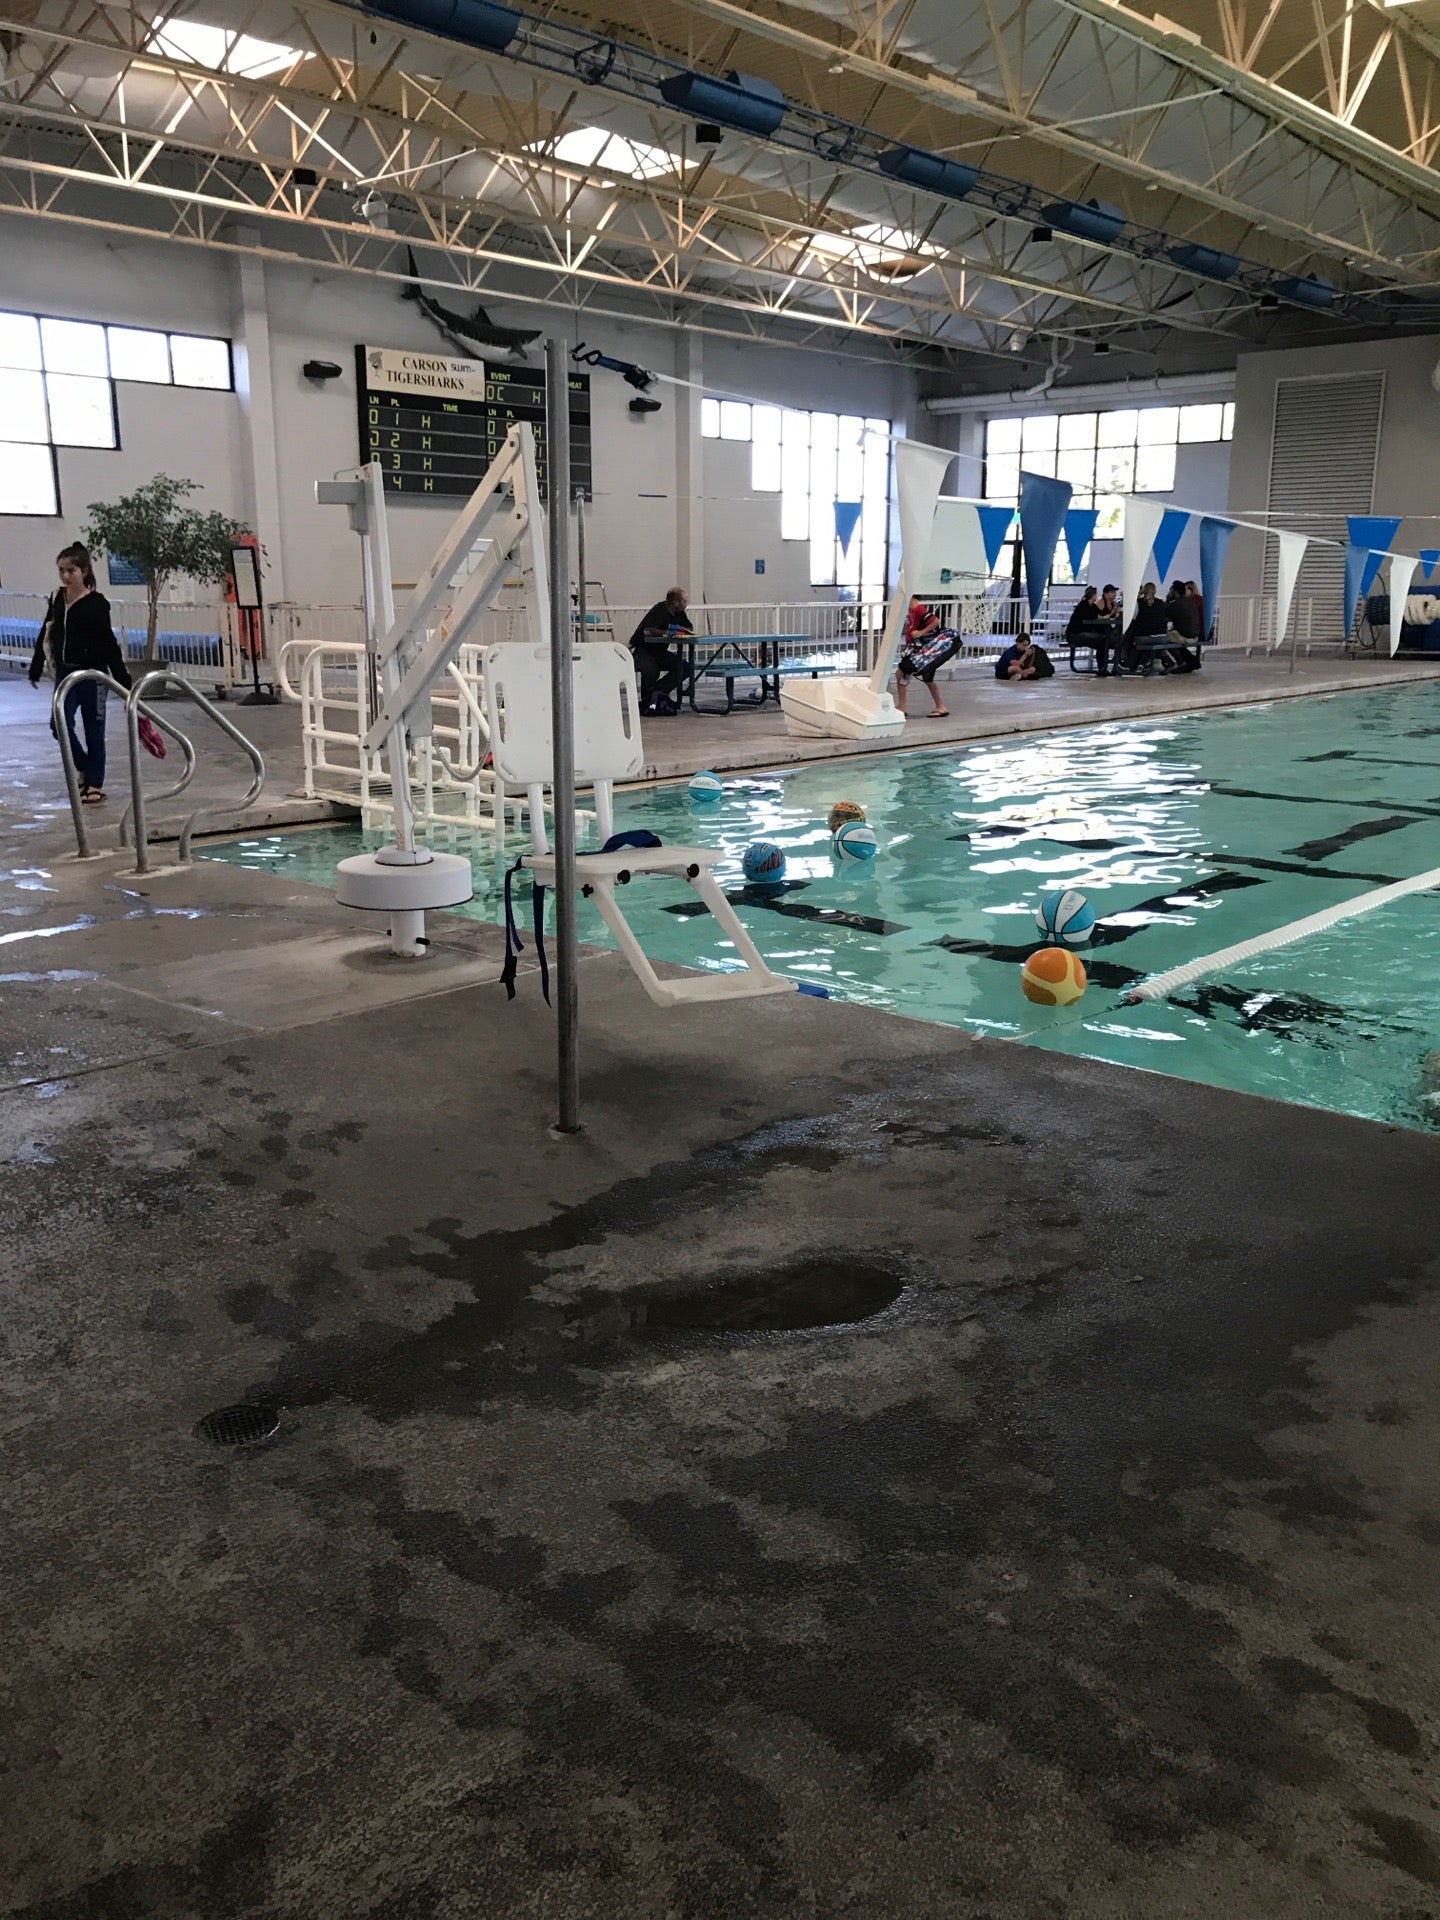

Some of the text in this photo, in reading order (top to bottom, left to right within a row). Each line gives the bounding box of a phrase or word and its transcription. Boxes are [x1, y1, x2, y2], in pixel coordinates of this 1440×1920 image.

[402, 357, 448, 373] CARSON
[386, 370, 465, 391] TIGERSHARKS
[491, 373, 512, 382] EVENT
[369, 396, 380, 405] LN
[442, 403, 458, 413] TIME
[488, 409, 497, 417] LN
[391, 432, 400, 448] 2
[392, 454, 401, 469] 3
[392, 475, 402, 490] 4
